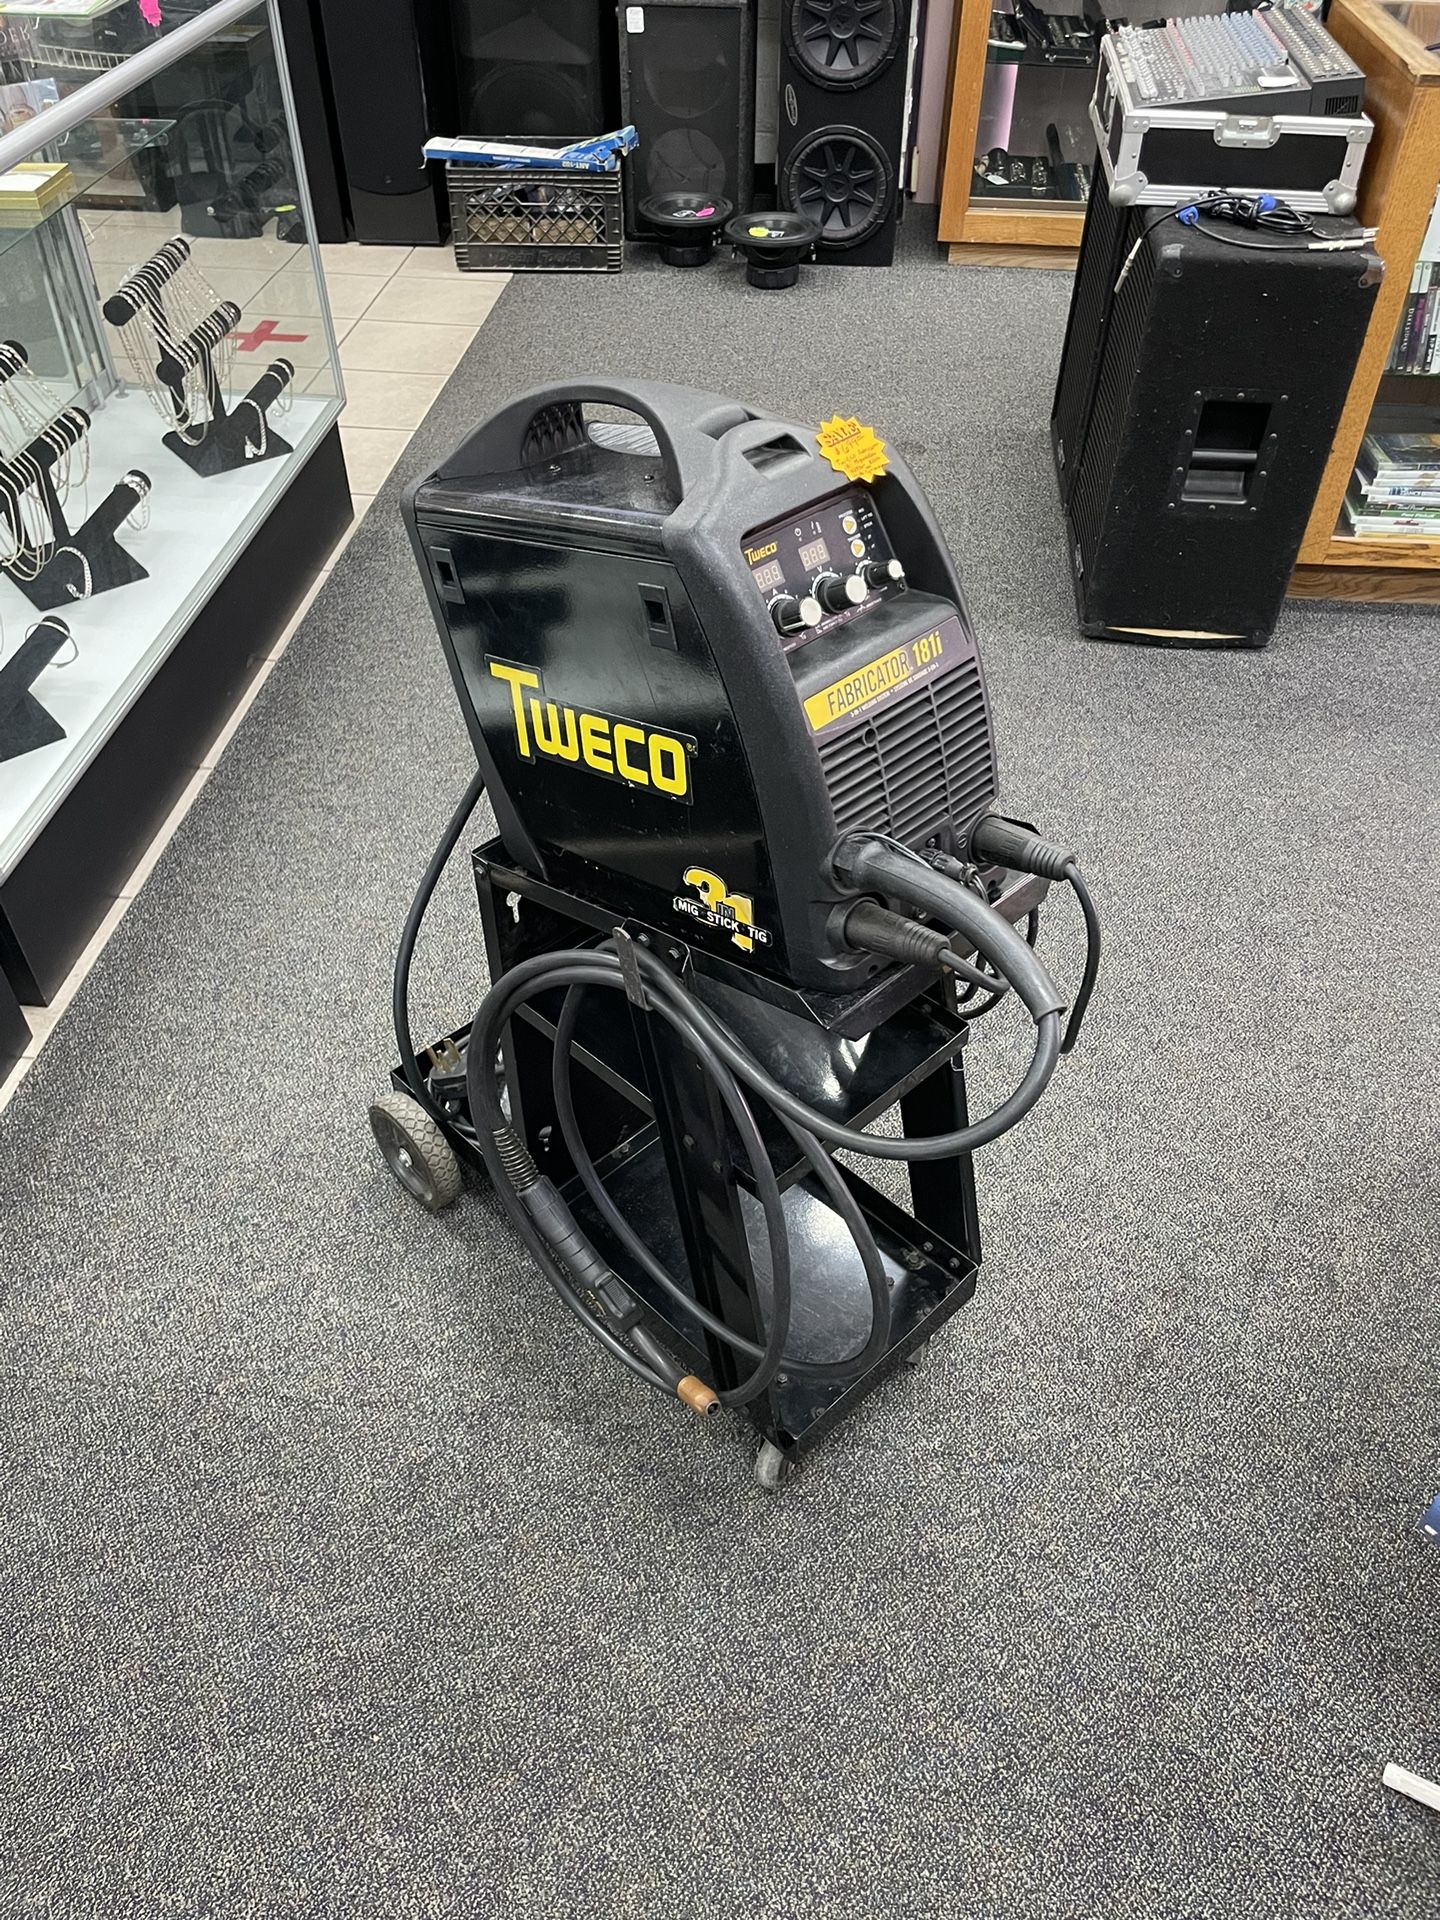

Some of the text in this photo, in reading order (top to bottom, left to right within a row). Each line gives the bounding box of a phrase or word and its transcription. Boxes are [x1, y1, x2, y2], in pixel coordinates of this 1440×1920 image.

[827, 630, 943, 716] FABRICATOR 181i
[678, 900, 768, 943] MIG STICK TIG
